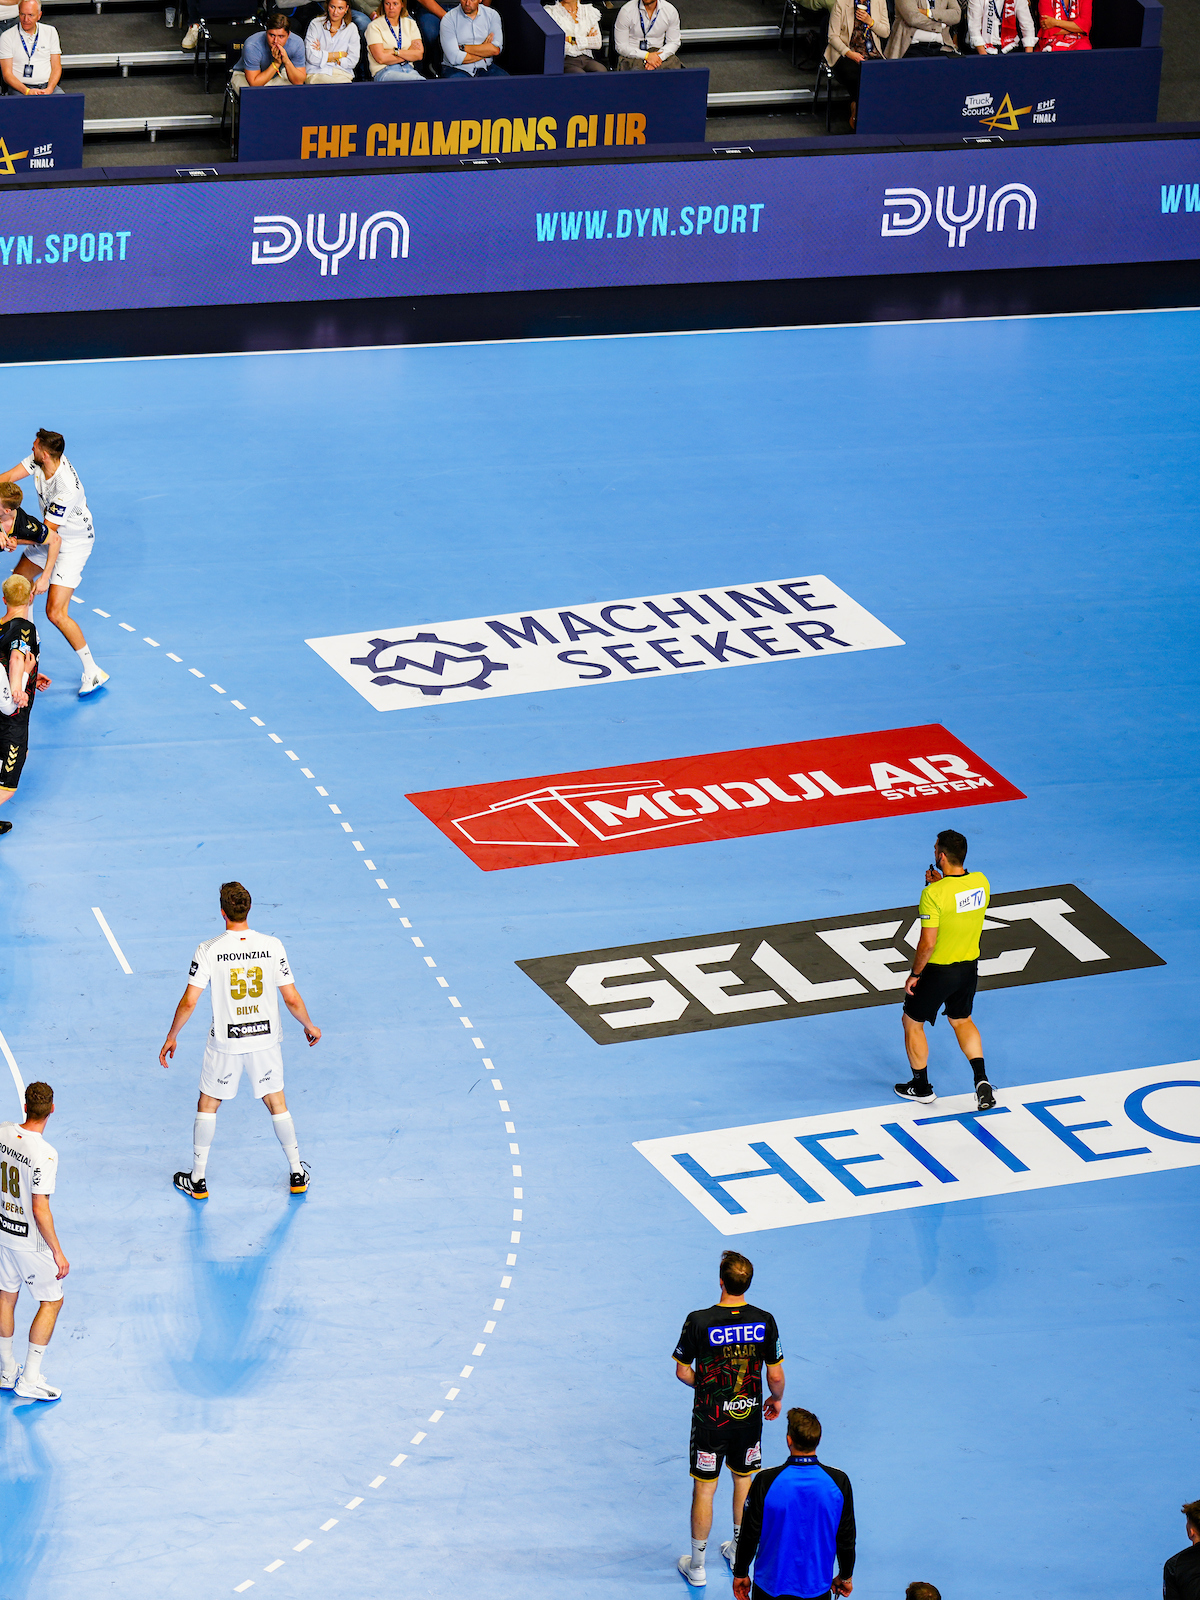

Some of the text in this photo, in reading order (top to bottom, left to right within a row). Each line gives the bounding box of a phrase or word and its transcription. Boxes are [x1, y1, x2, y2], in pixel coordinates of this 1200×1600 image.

[961, 106, 995, 116] Scout24
[968, 97, 990, 105] Truck
[1037, 99, 1056, 110] EHF
[1032, 113, 1056, 123] FINAL4
[33, 143, 53, 155] EHF
[300, 124, 357, 160] EHF
[366, 116, 557, 157] CHAMPIONS
[30, 158, 54, 169] FINAL4
[535, 203, 765, 242] WWW.DYN.SPORT
[881, 182, 1038, 248] DYN
[251, 210, 410, 276] DYN
[485, 580, 838, 650] MACHINE
[557, 619, 854, 681] SEEKER
[596, 753, 985, 827] MODULAR
[880, 775, 995, 802] SYSTEM
[217, 951, 272, 962] PROVINZIAL
[229, 966, 263, 1000] 53
[236, 1004, 259, 1016] BILYK
[241, 1023, 269, 1034] ORLEN
[672, 1080, 1200, 1215] HEITEC
[0, 1160, 20, 1199] 18
[2, 1221, 27, 1234] ORLEN
[709, 1324, 766, 1344] GETEC
[731, 1358, 749, 1393] 7
